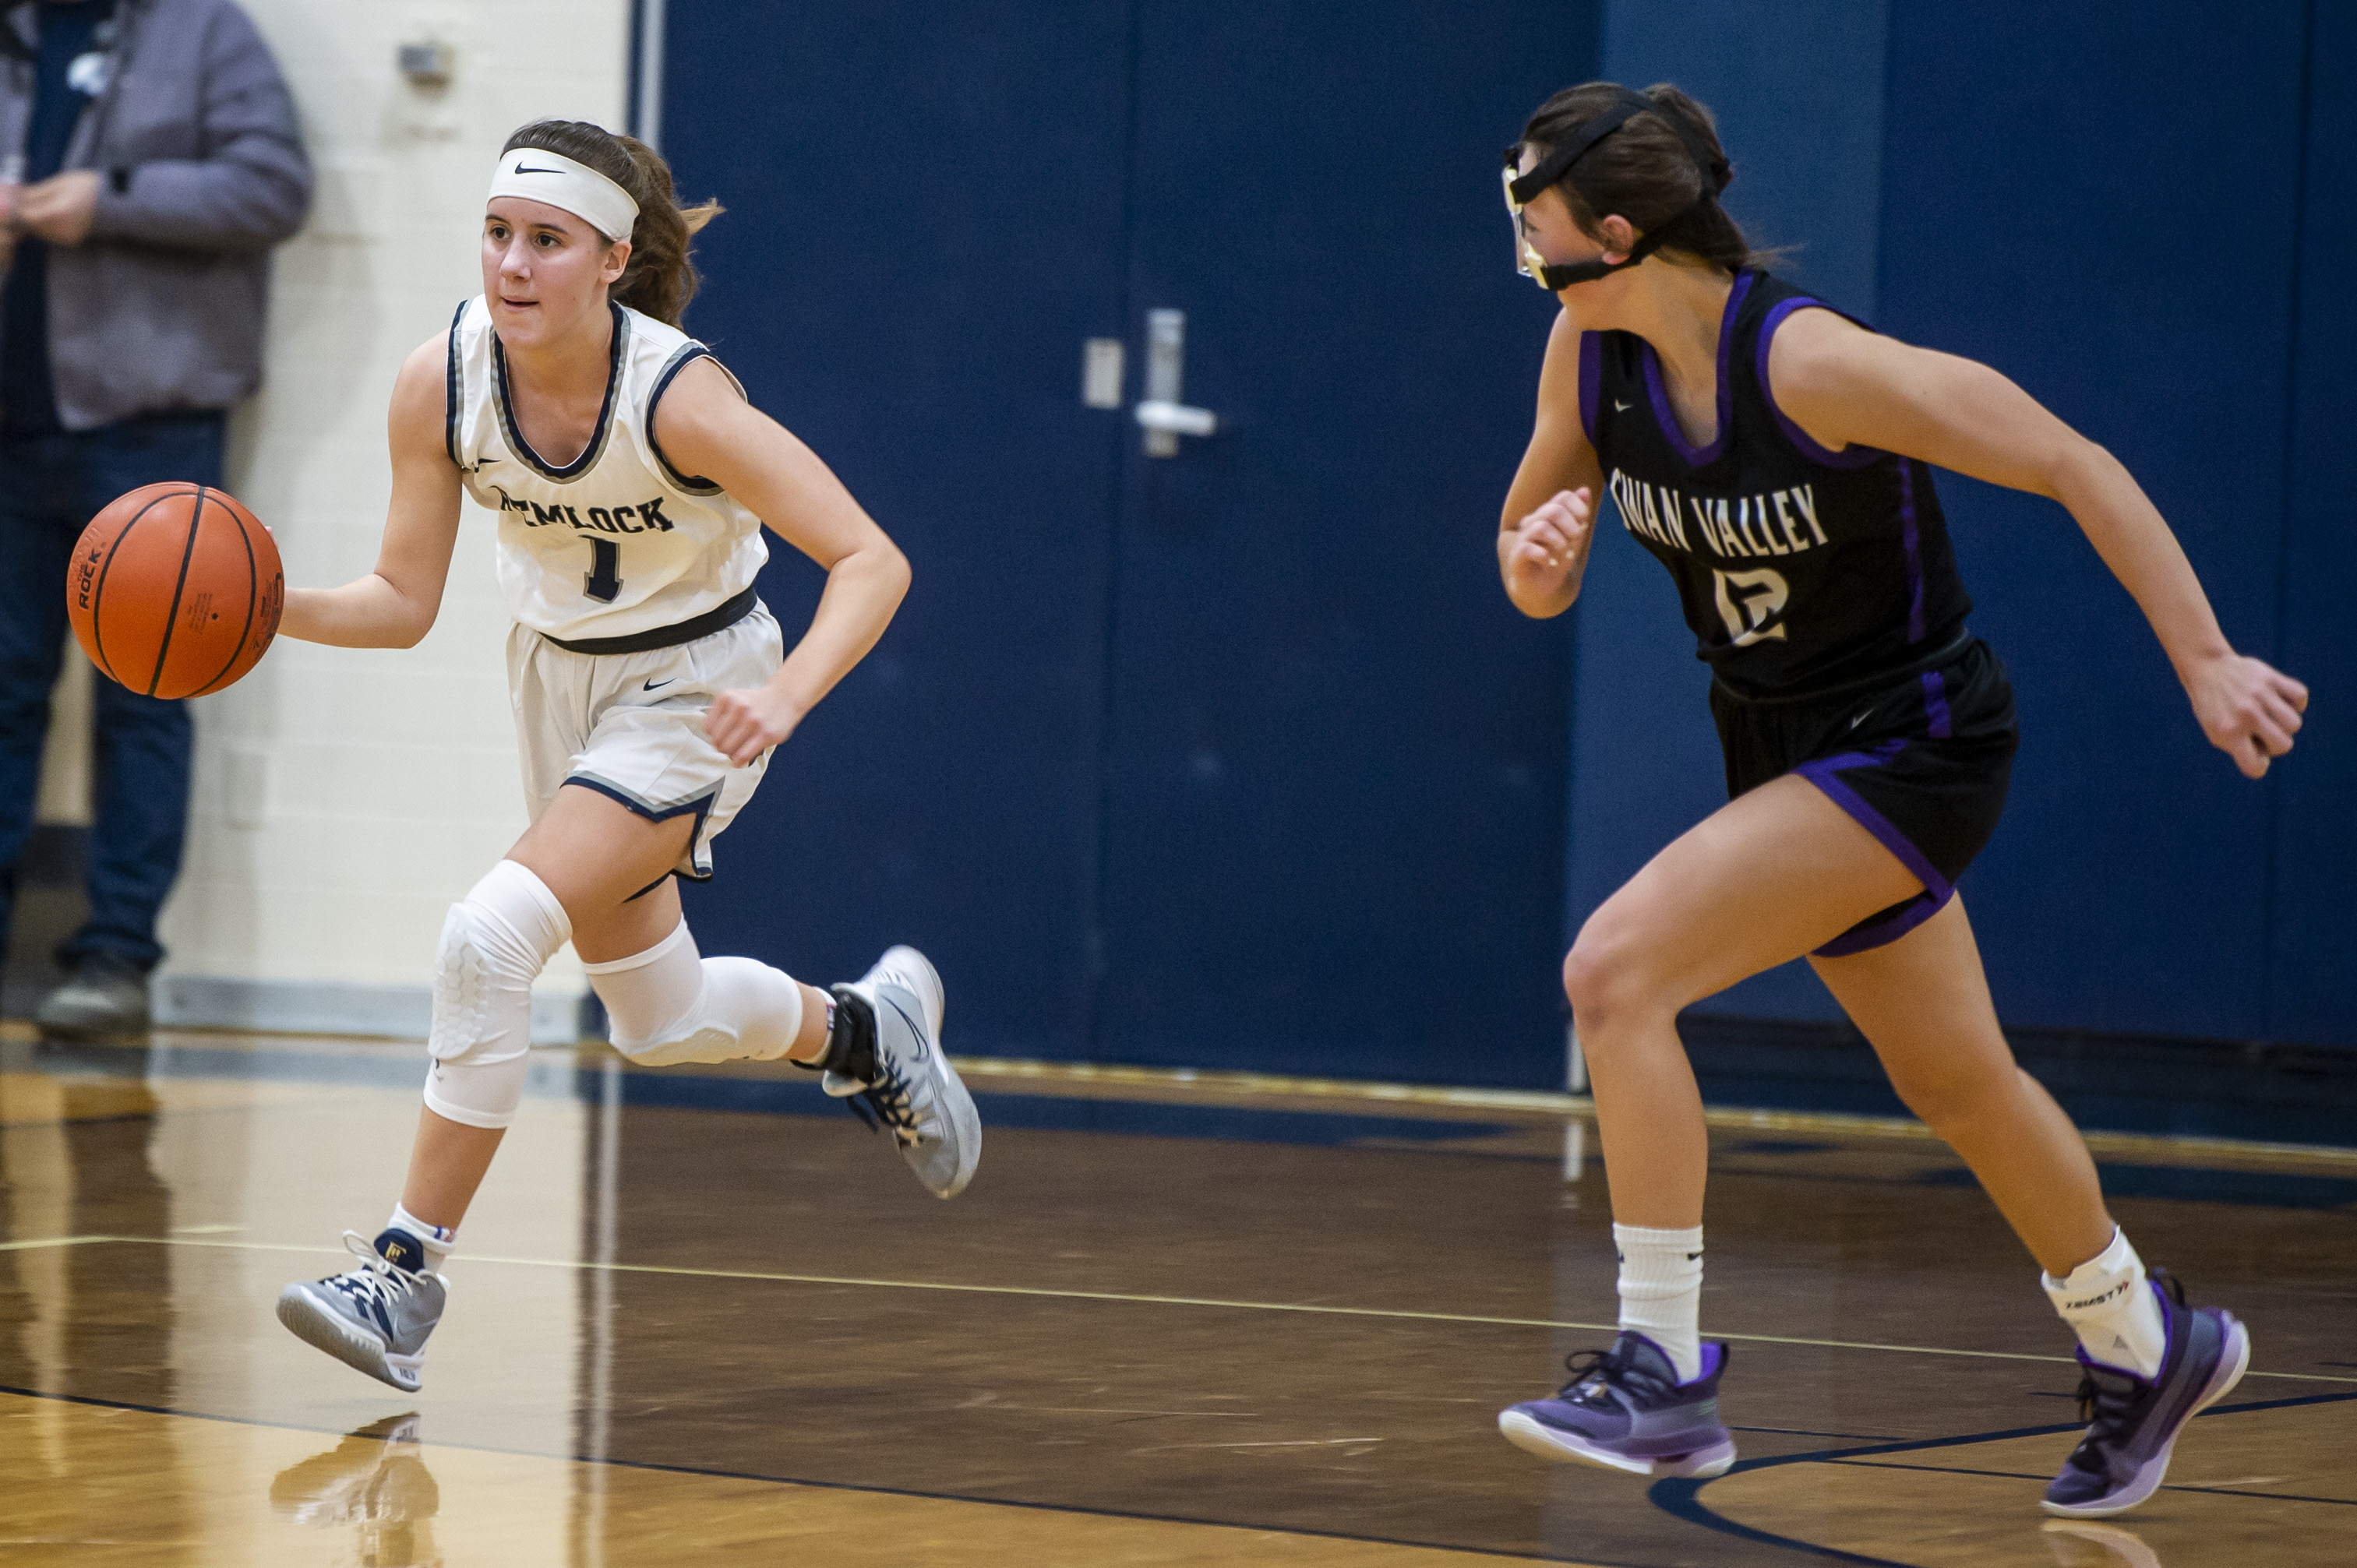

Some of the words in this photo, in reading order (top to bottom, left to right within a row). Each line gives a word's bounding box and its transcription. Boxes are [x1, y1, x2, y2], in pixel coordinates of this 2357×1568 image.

[1690, 484, 1829, 557] VALLEY
[79, 548, 102, 610] ROCK
[579, 534, 623, 604] 1
[1713, 567, 1790, 647] 12
